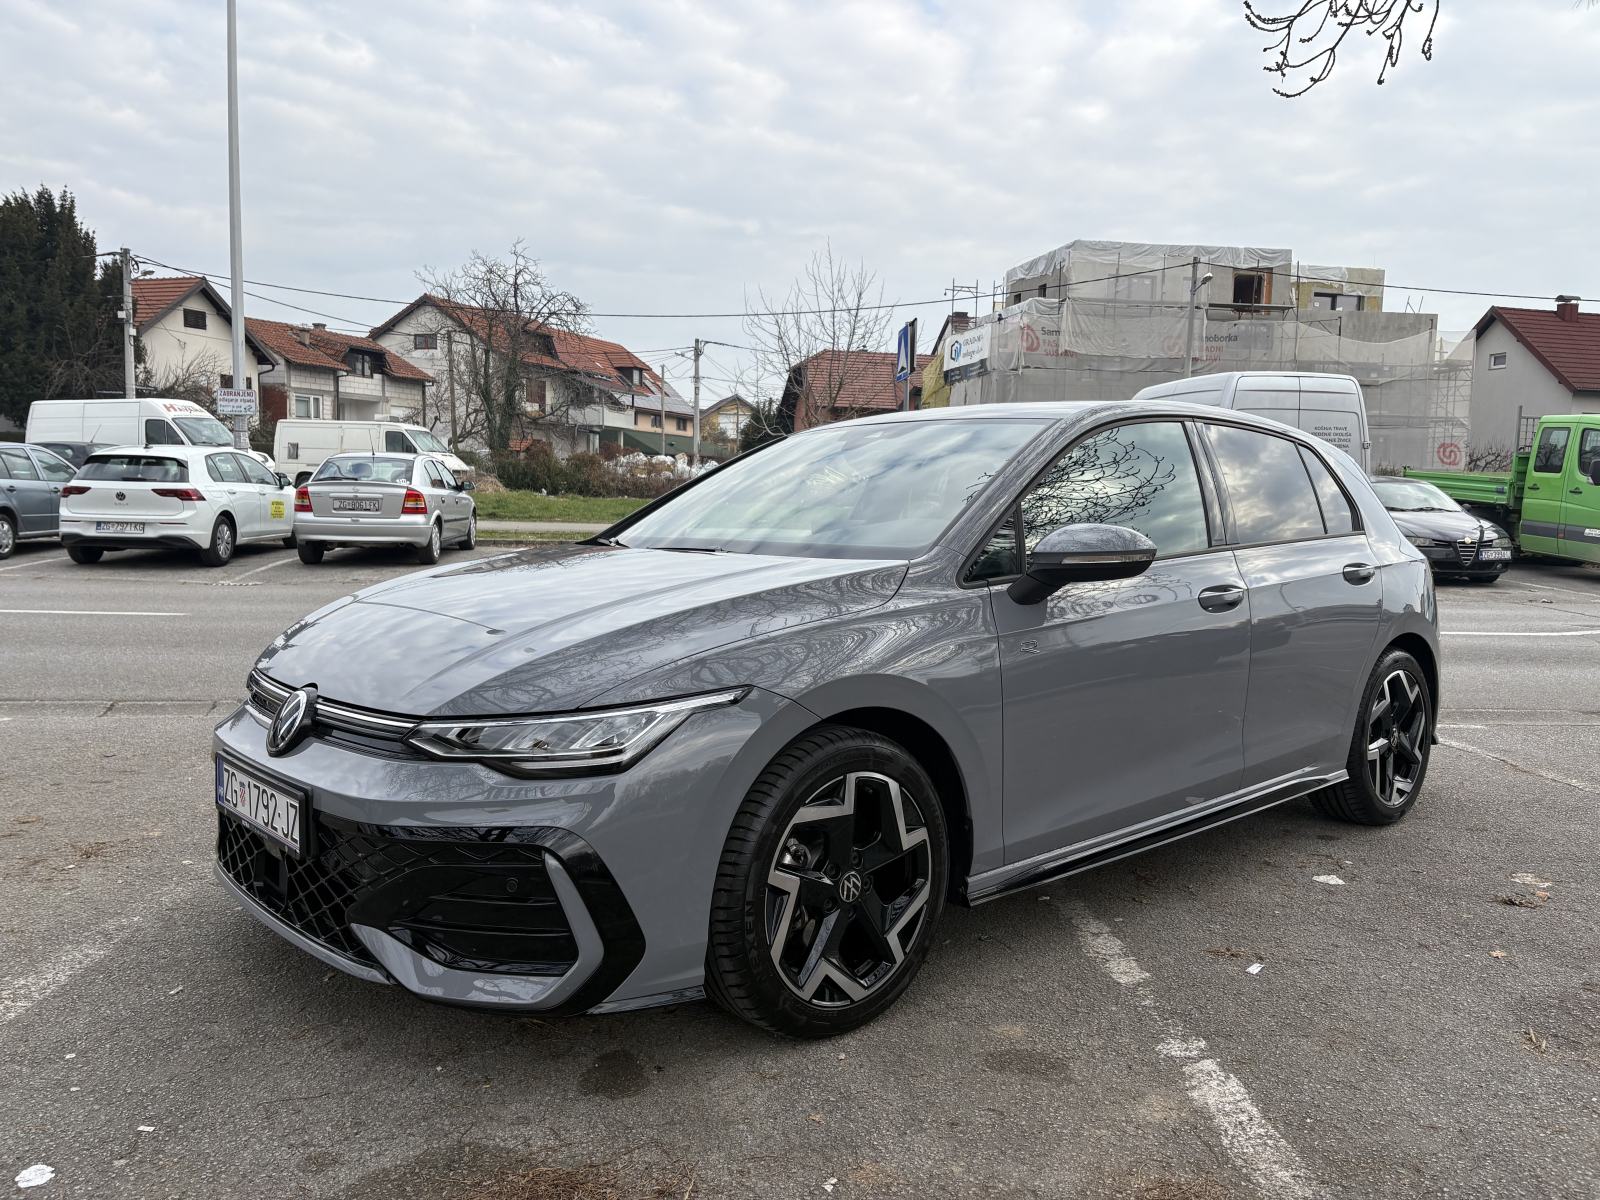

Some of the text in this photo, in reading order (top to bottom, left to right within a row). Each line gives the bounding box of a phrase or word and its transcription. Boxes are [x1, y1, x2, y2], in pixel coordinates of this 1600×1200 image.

[1198, 333, 1238, 343] moborka
[219, 390, 253, 398] ZABRANJENO
[223, 766, 238, 808] ZG
